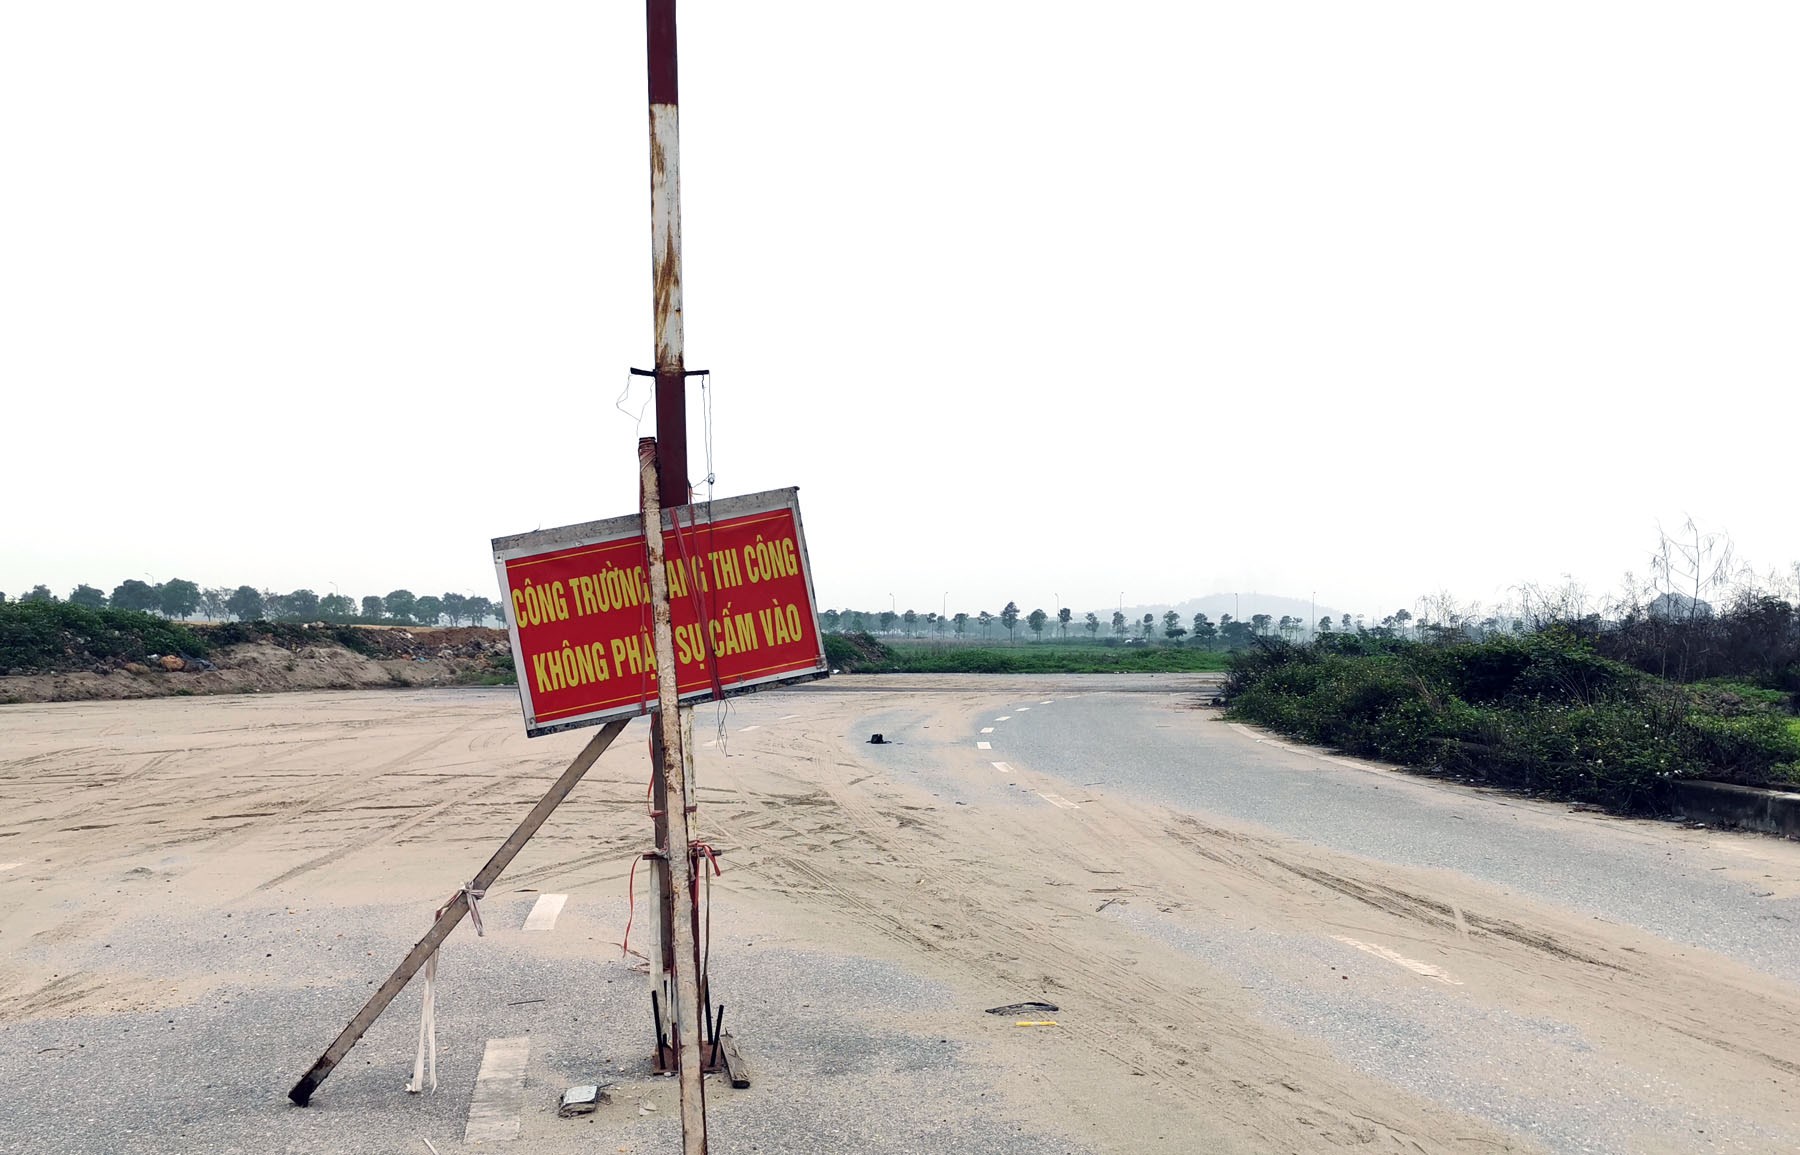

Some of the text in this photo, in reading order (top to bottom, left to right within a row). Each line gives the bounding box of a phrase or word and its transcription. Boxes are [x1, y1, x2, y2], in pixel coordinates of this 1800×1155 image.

[511, 534, 799, 628] CÔNG TRƯỜNG ANG THI CÔNG
[532, 639, 610, 693] KHÔNG
[610, 624, 657, 680] PHẬ
[708, 601, 759, 658] CẤM
[758, 598, 803, 647] VÀO
